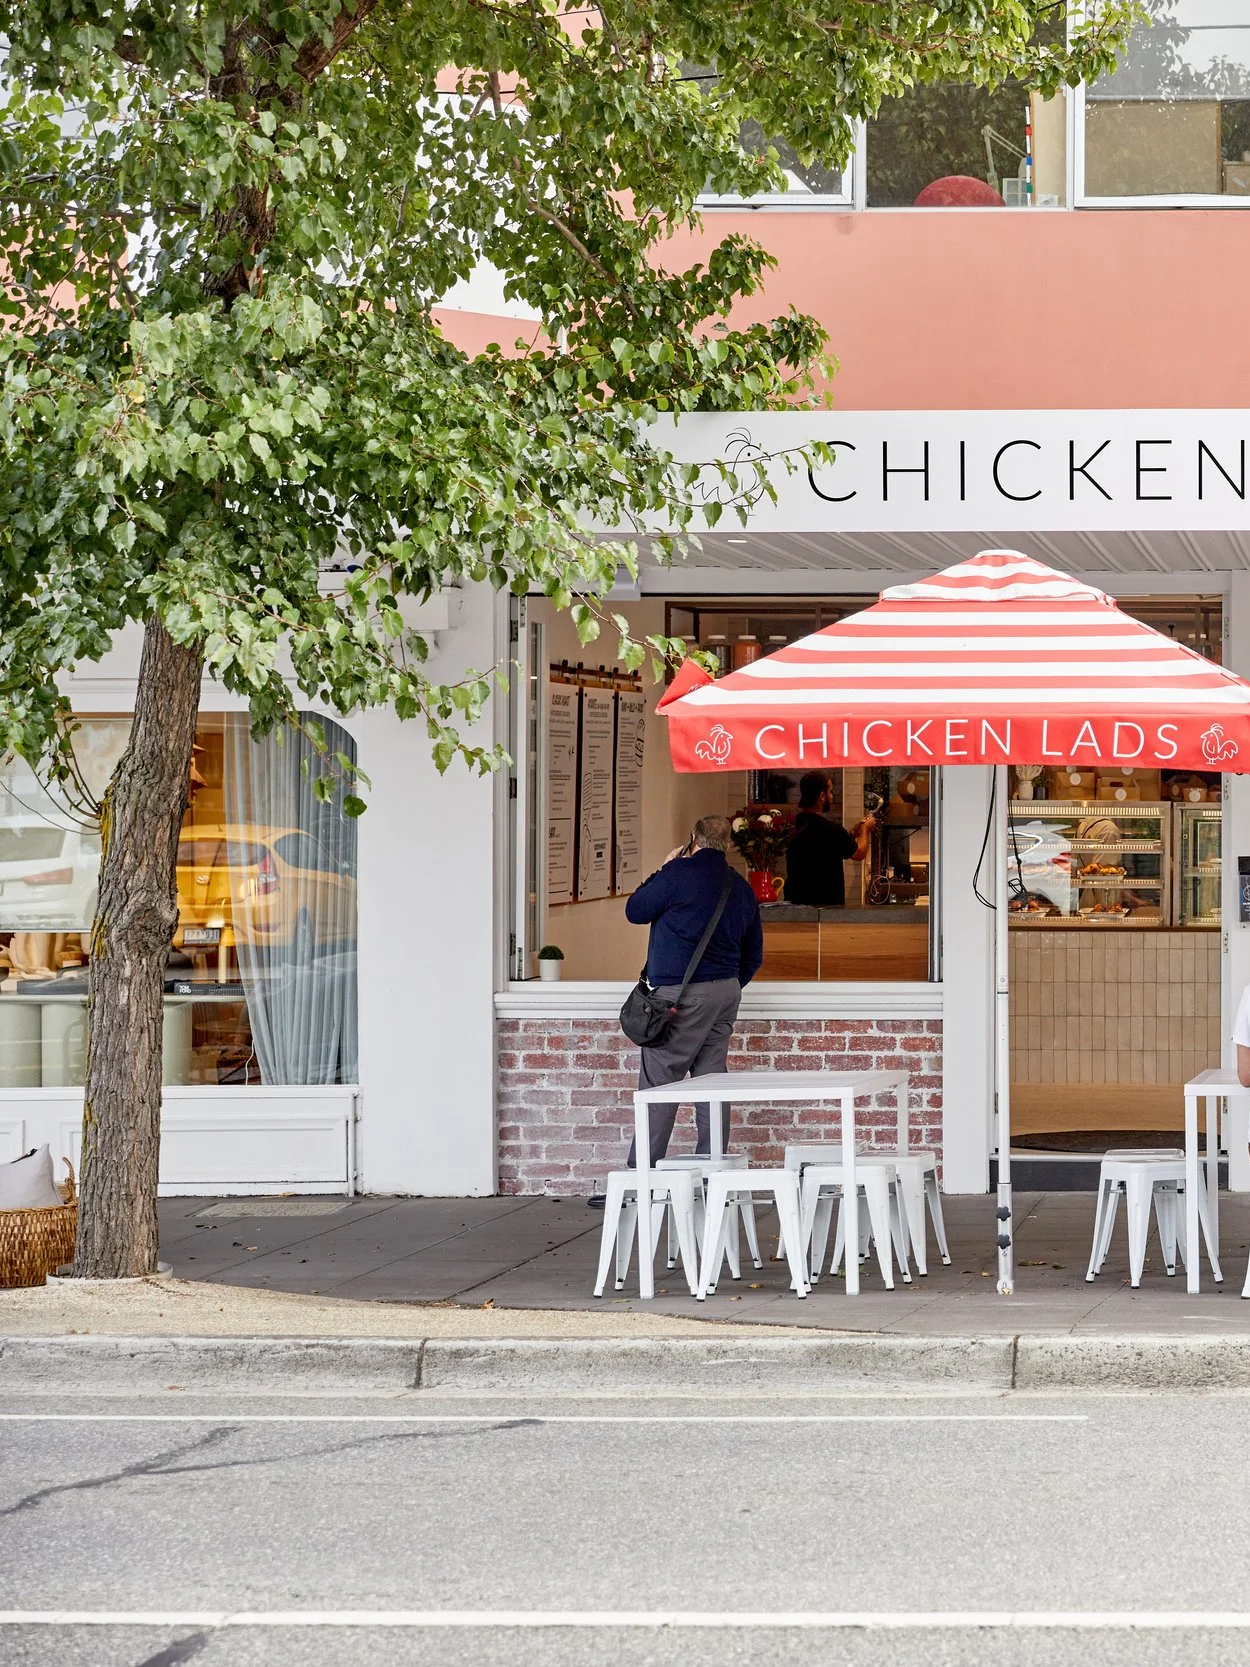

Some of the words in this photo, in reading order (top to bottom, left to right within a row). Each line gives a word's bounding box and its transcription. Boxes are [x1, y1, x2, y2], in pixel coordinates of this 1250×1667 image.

[807, 439, 1246, 502] CHICKEN
[754, 718, 1012, 760] CHICKEN
[1040, 720, 1180, 761] LADS
